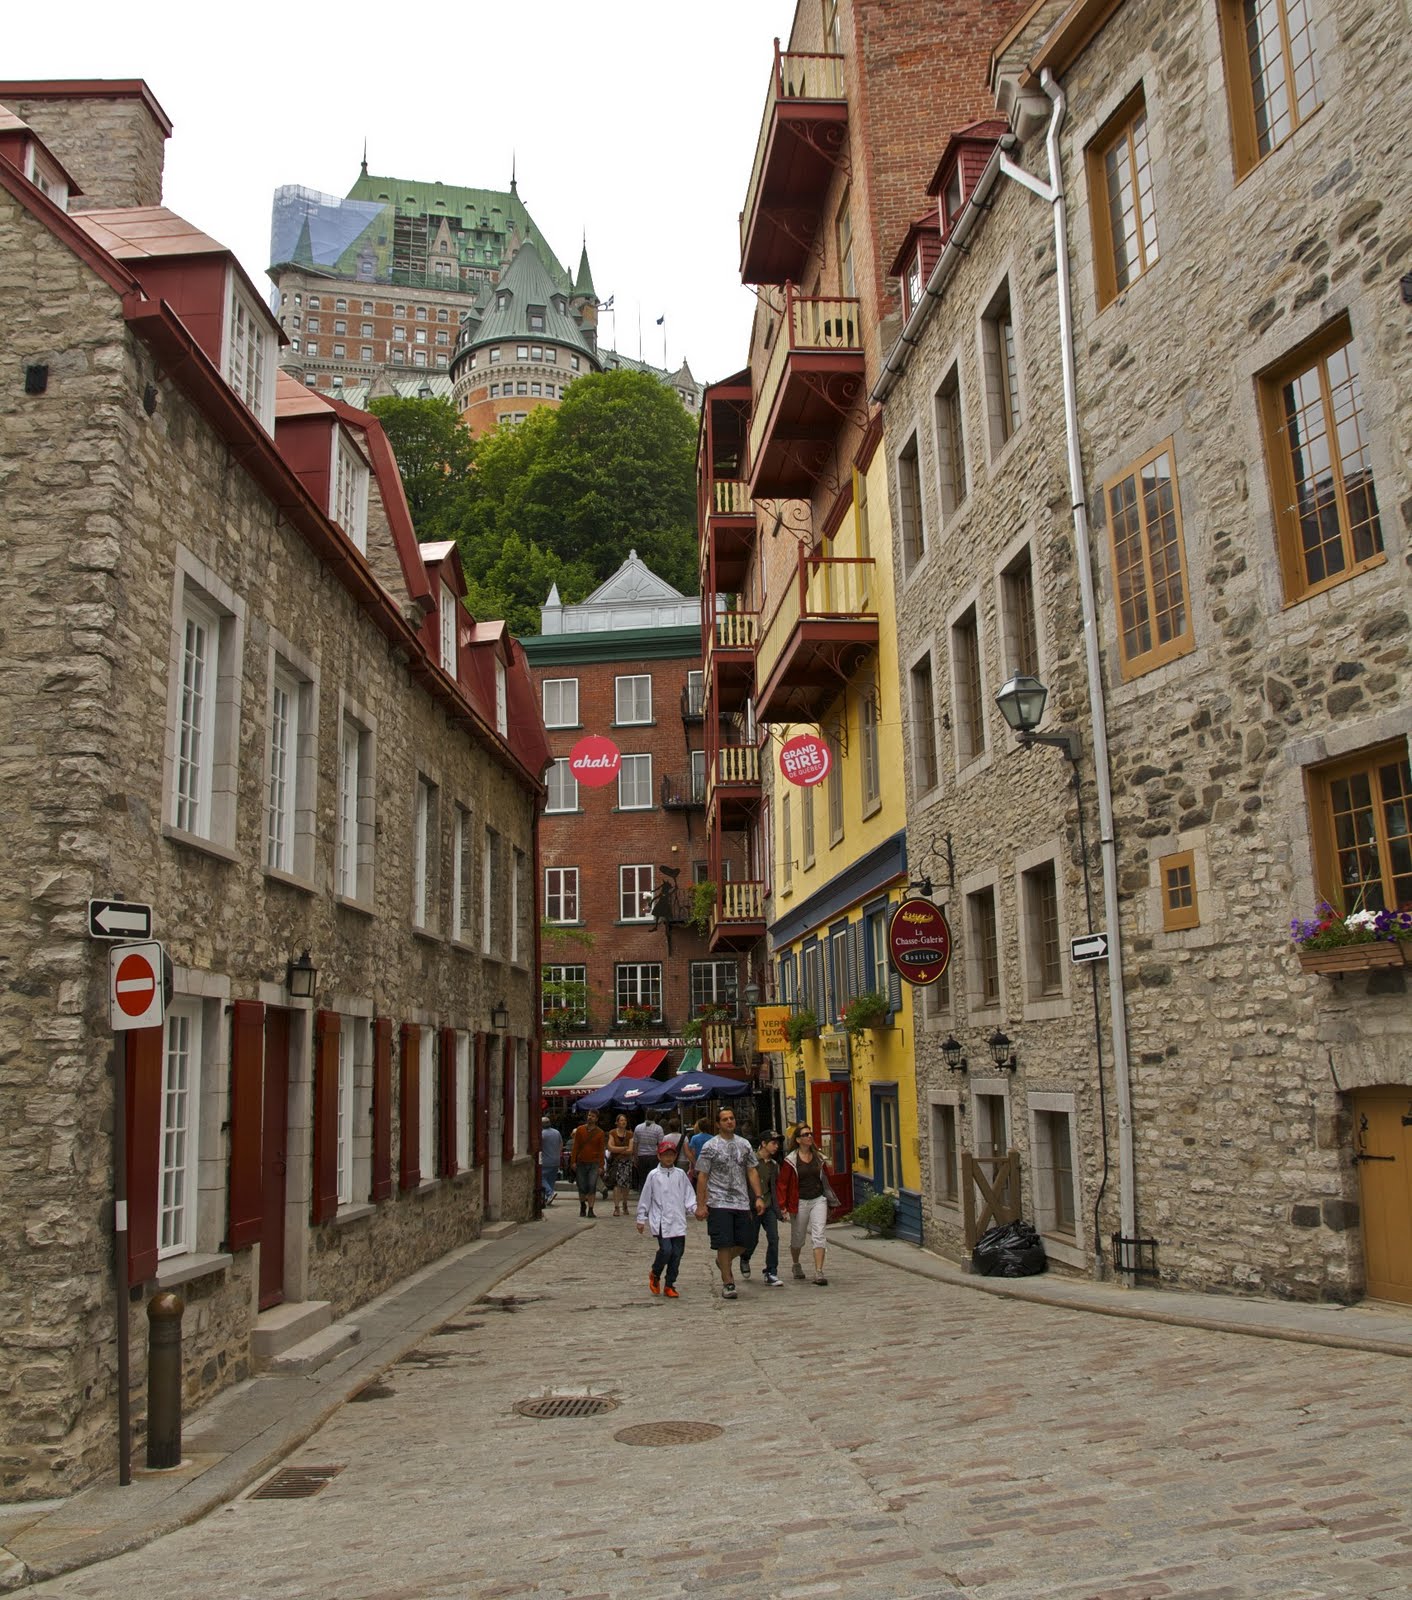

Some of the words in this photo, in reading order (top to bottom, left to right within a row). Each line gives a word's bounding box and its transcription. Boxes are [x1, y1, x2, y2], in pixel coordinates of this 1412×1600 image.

[783, 744, 816, 760] GRAND
[573, 754, 618, 768] ahah!
[785, 751, 821, 772] RIRE
[798, 763, 822, 775] QUÉBEC
[896, 936, 943, 945] Chasse-Galerie
[905, 953, 938, 961] Boutique
[551, 1039, 606, 1049] RESTAURANT
[614, 1038, 661, 1048] TRATTORIA
